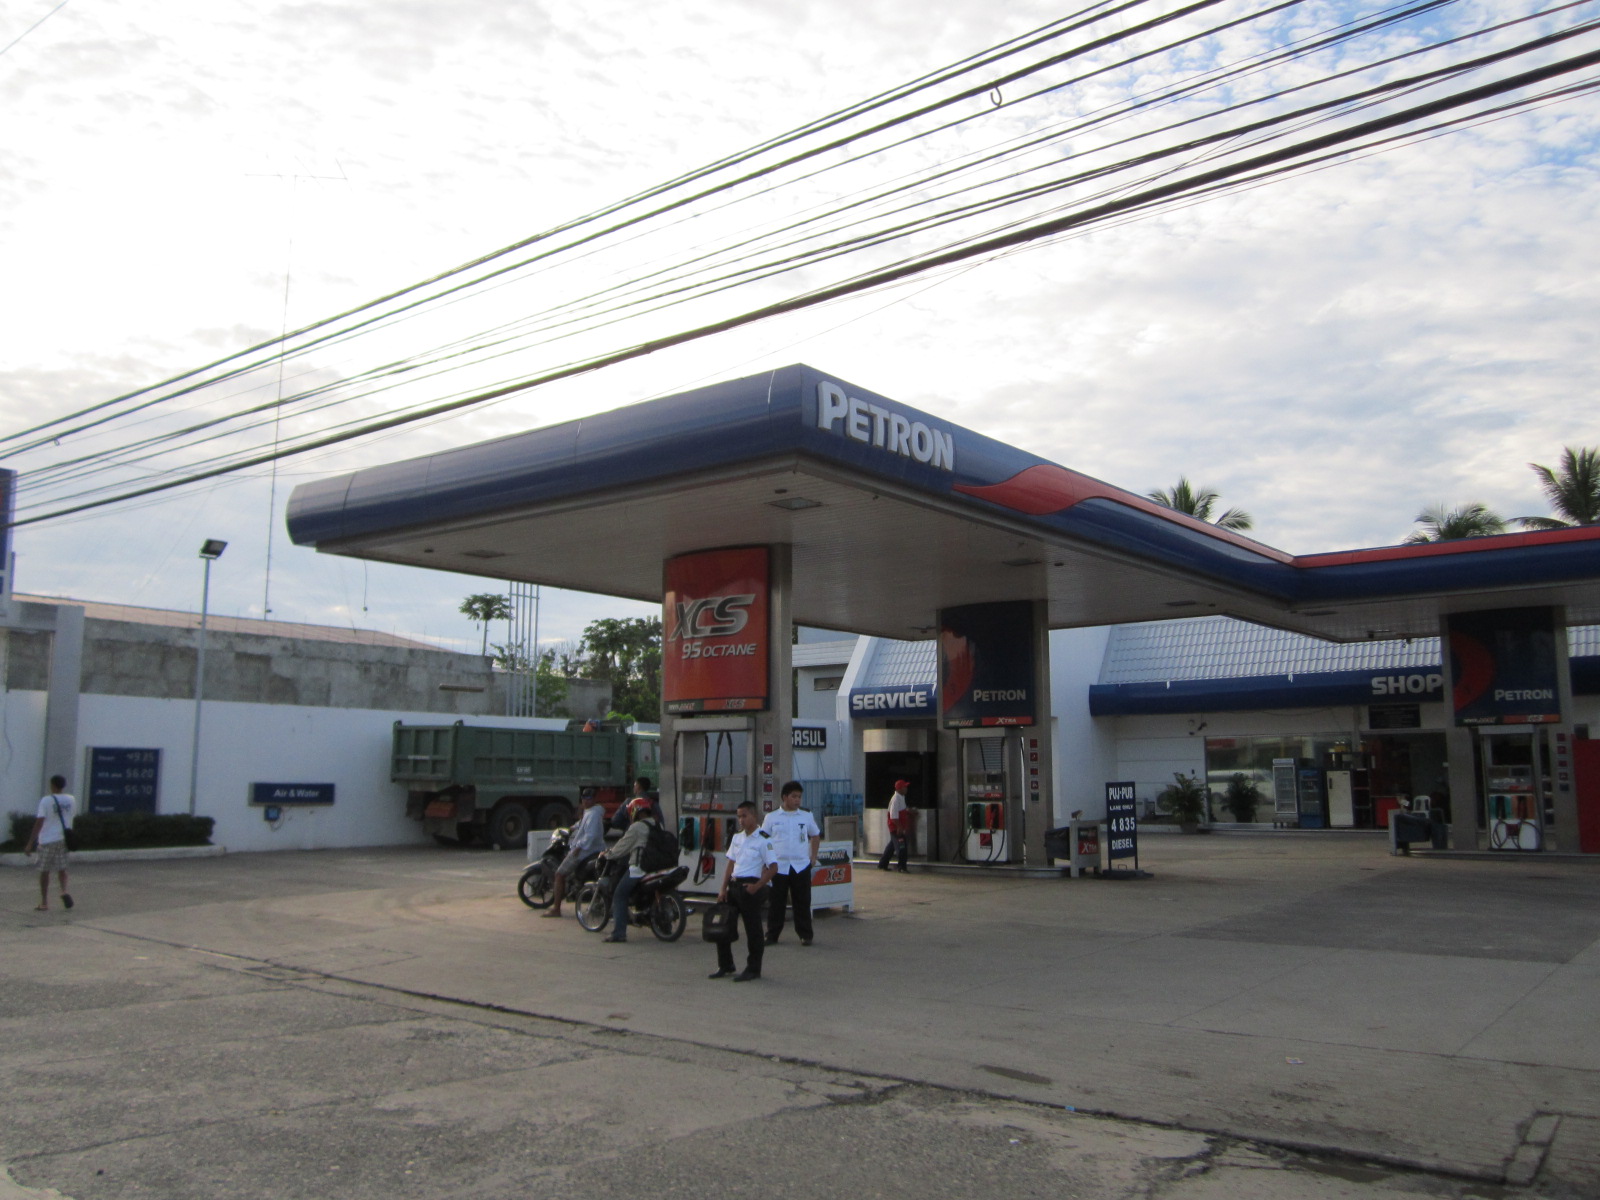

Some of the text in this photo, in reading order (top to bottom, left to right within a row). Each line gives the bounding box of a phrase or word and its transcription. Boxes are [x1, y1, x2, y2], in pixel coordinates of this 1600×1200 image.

[817, 381, 953, 471] PETRON
[668, 594, 756, 642] XCS
[681, 642, 758, 660] 95 OCTANE
[1371, 674, 1444, 695] SHOP
[852, 691, 928, 710] SERVICE
[973, 688, 1027, 702] PETRON
[1494, 688, 1553, 701] PETRON
[273, 789, 320, 797] Air & Water
[1112, 838, 1133, 850] DIESEL
[824, 867, 847, 882] XCS
